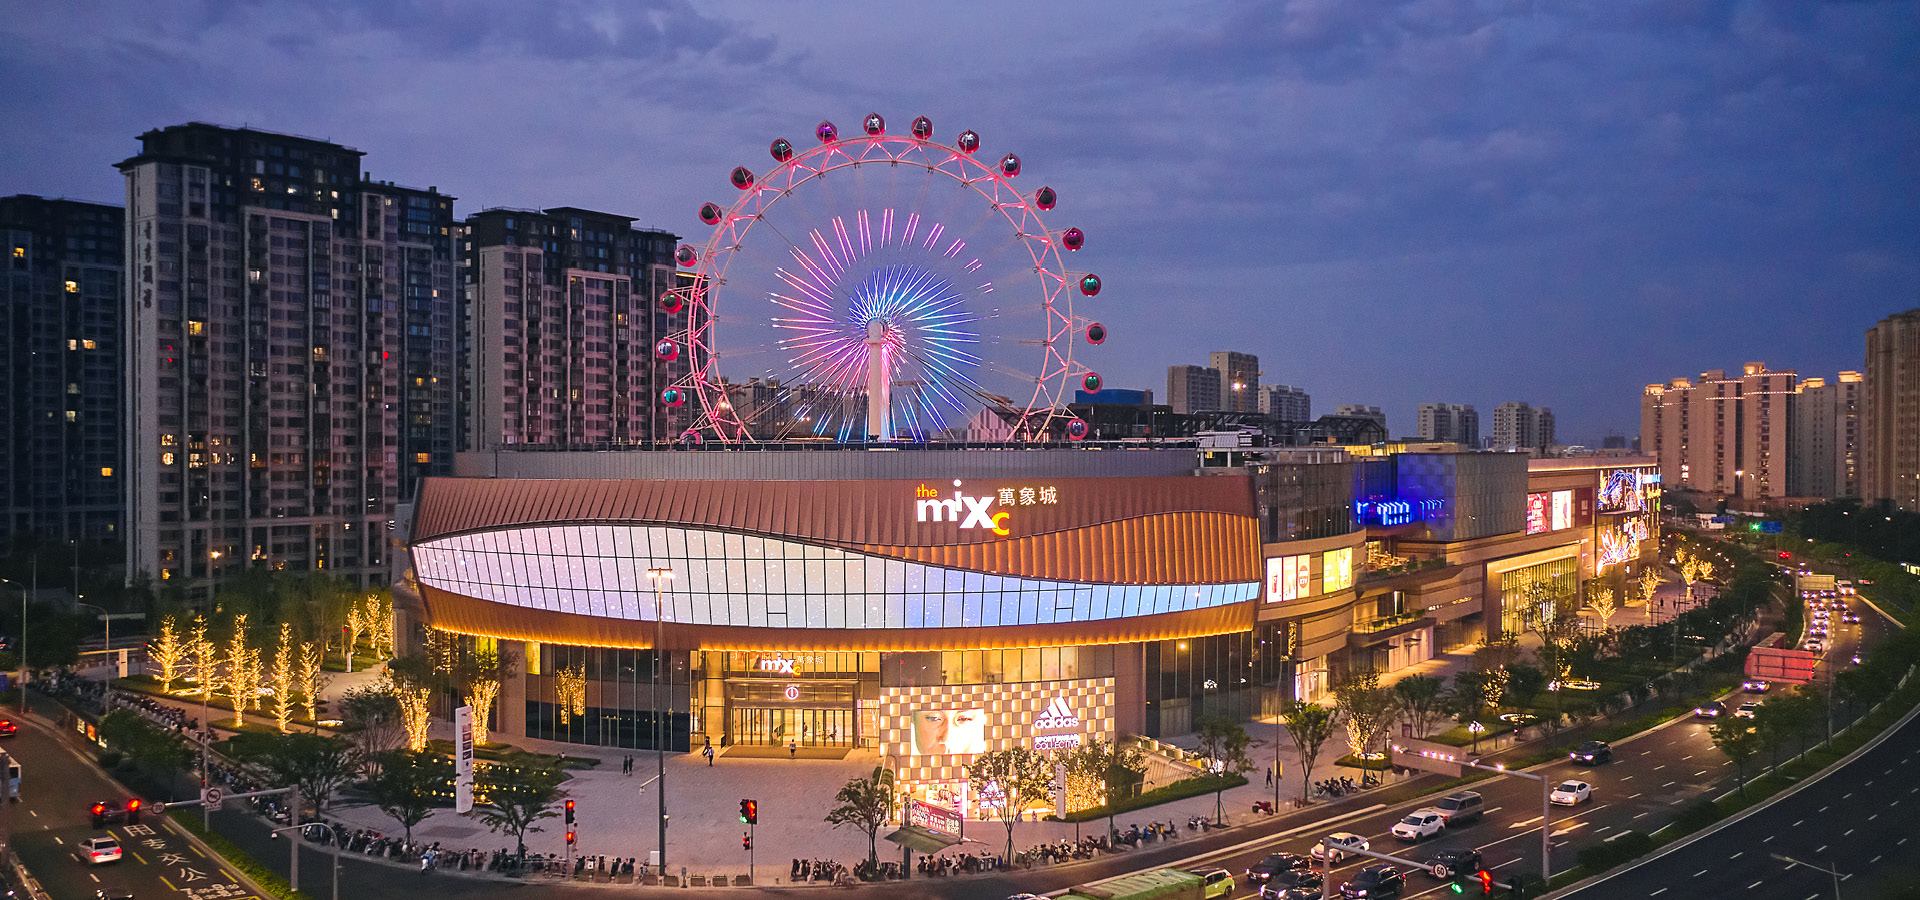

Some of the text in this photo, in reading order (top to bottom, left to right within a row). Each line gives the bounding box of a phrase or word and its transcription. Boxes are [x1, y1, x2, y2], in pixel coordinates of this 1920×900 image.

[917, 484, 938, 497] the
[998, 486, 1057, 506] 萬象城
[1034, 716, 1080, 729] adidas
[1437, 866, 1444, 875] 60
